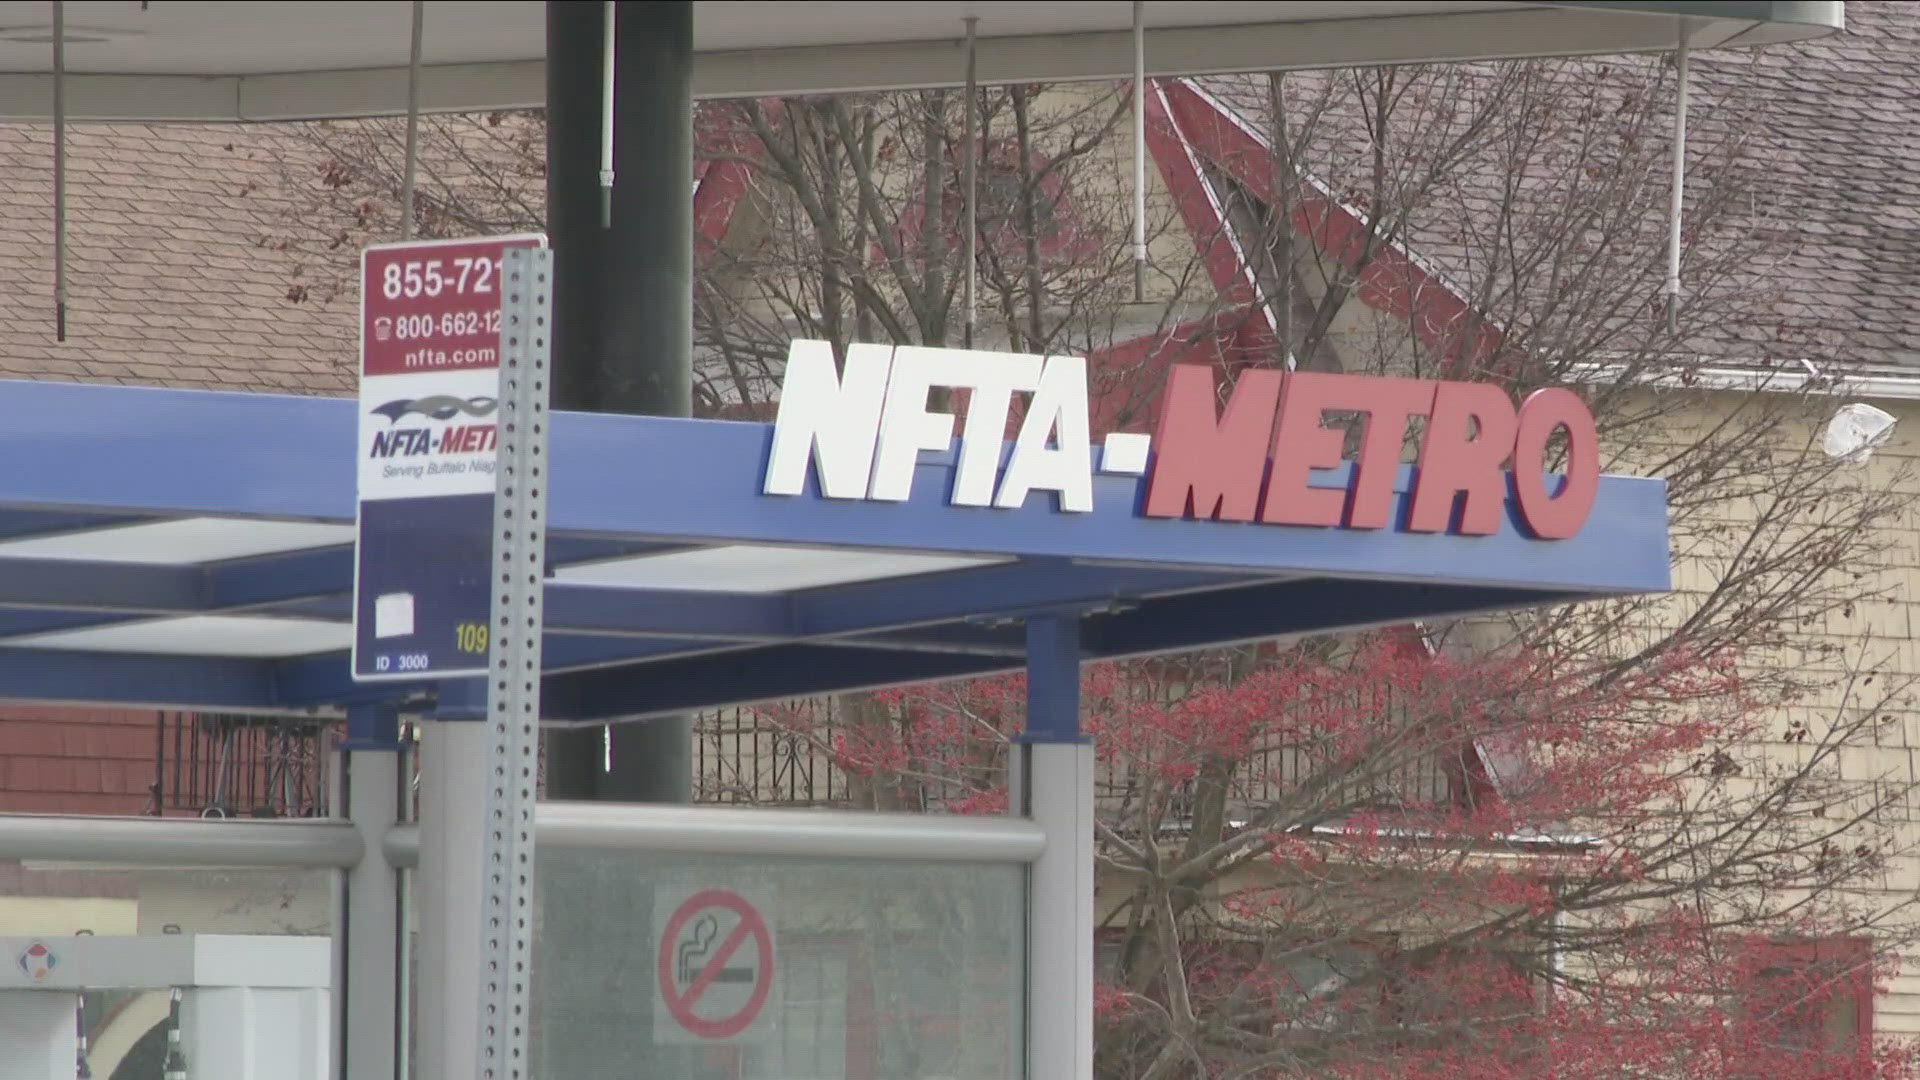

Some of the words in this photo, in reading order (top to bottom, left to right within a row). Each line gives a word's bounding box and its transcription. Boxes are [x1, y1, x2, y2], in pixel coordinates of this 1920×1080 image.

[405, 348, 496, 367] nfta.com
[763, 339, 1600, 540] NFTA-METRO
[382, 464, 424, 479] Serving
[426, 462, 465, 475] Buffalo
[456, 623, 488, 654] 109
[376, 656, 390, 670] ID
[398, 654, 429, 670] 3000
